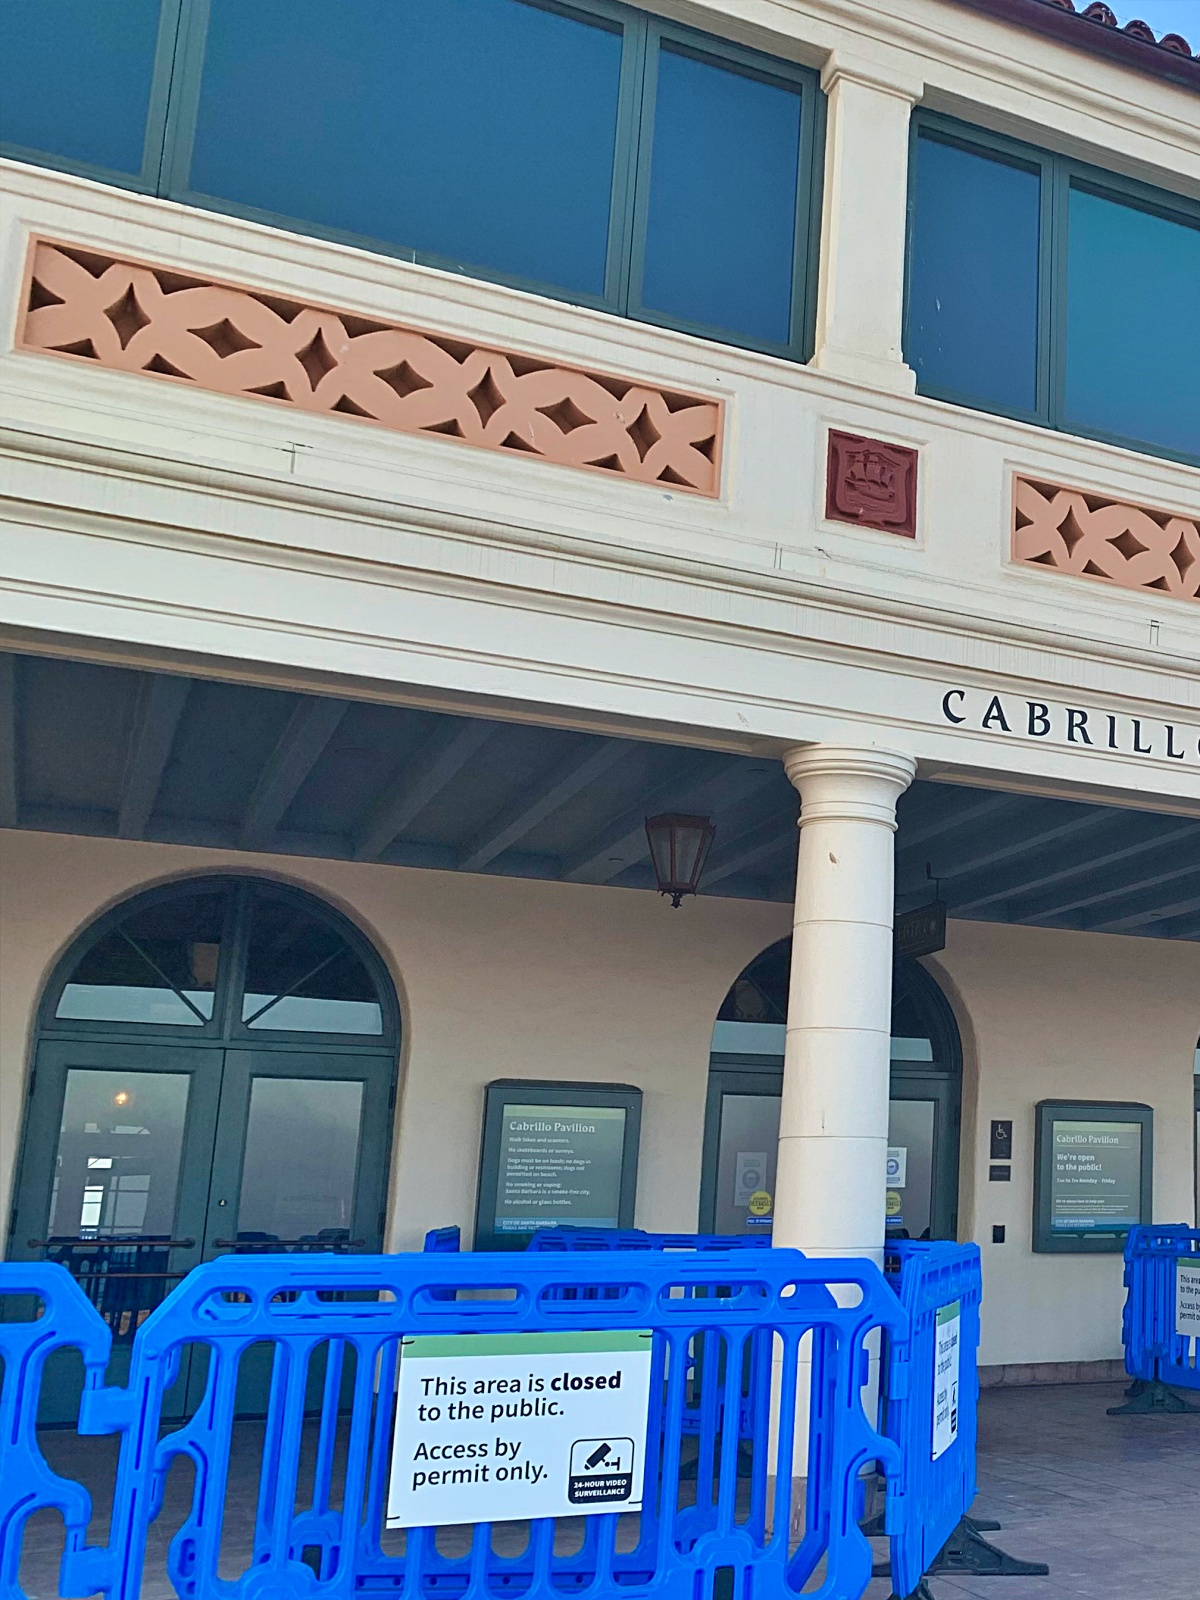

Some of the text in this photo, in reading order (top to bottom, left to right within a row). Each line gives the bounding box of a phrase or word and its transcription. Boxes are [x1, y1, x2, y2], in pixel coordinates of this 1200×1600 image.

[509, 1121, 595, 1133] Cabrillo Pavilion
[1056, 1134, 1119, 1144] Cabrillo Pavilion
[1057, 1153, 1077, 1161] We're
[1066, 1163, 1077, 1171] the
[1078, 1163, 1102, 1172] public!
[1180, 1275, 1190, 1283] This
[1191, 1276, 1200, 1285] area
[1180, 1285, 1185, 1293] to
[1180, 1301, 1196, 1310] Access
[1180, 1312, 1195, 1320] permit
[420, 1371, 622, 1396] This area is closed
[418, 1397, 565, 1422] to the public.
[413, 1437, 522, 1461] Access by
[412, 1461, 548, 1491] permit only.
[573, 1479, 627, 1490] 24-HOUR VIDEO
[574, 1487, 625, 1498] SURVEILLANCE
